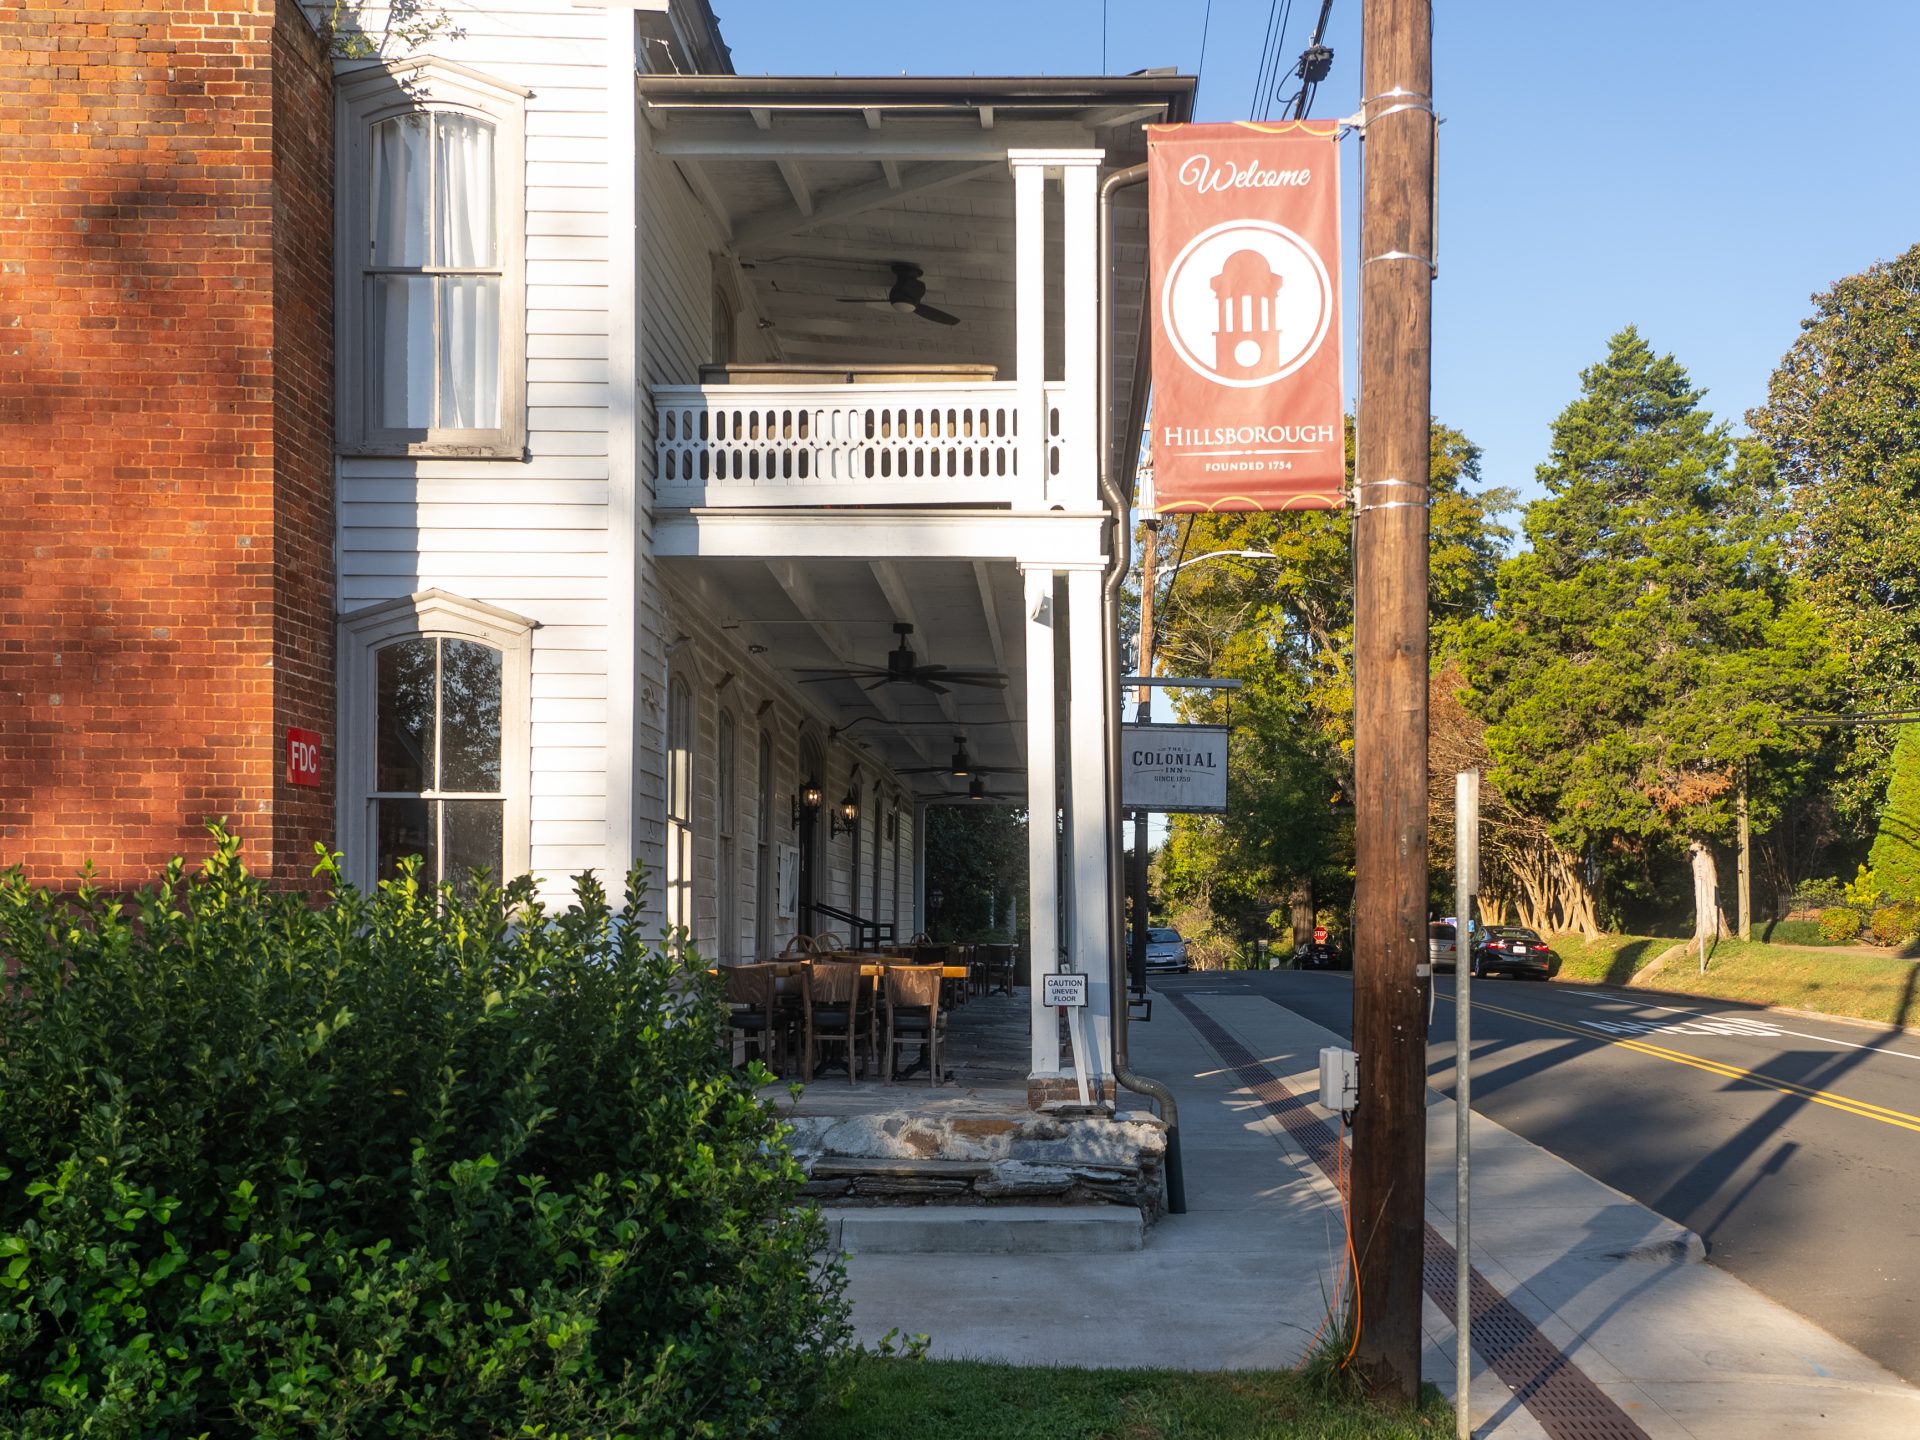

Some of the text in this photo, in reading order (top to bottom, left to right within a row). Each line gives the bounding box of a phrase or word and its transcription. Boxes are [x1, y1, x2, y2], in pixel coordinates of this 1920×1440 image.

[1178, 155, 1311, 194] Welcome
[1164, 425, 1334, 446] HILLSBOROUGH
[1205, 460, 1292, 473] FOUNDED 1754
[291, 740, 317, 774] FDC
[1133, 750, 1216, 768] COLONIAL
[1047, 979, 1083, 987] CAUTION
[1577, 1019, 1782, 1037] AHEAD
